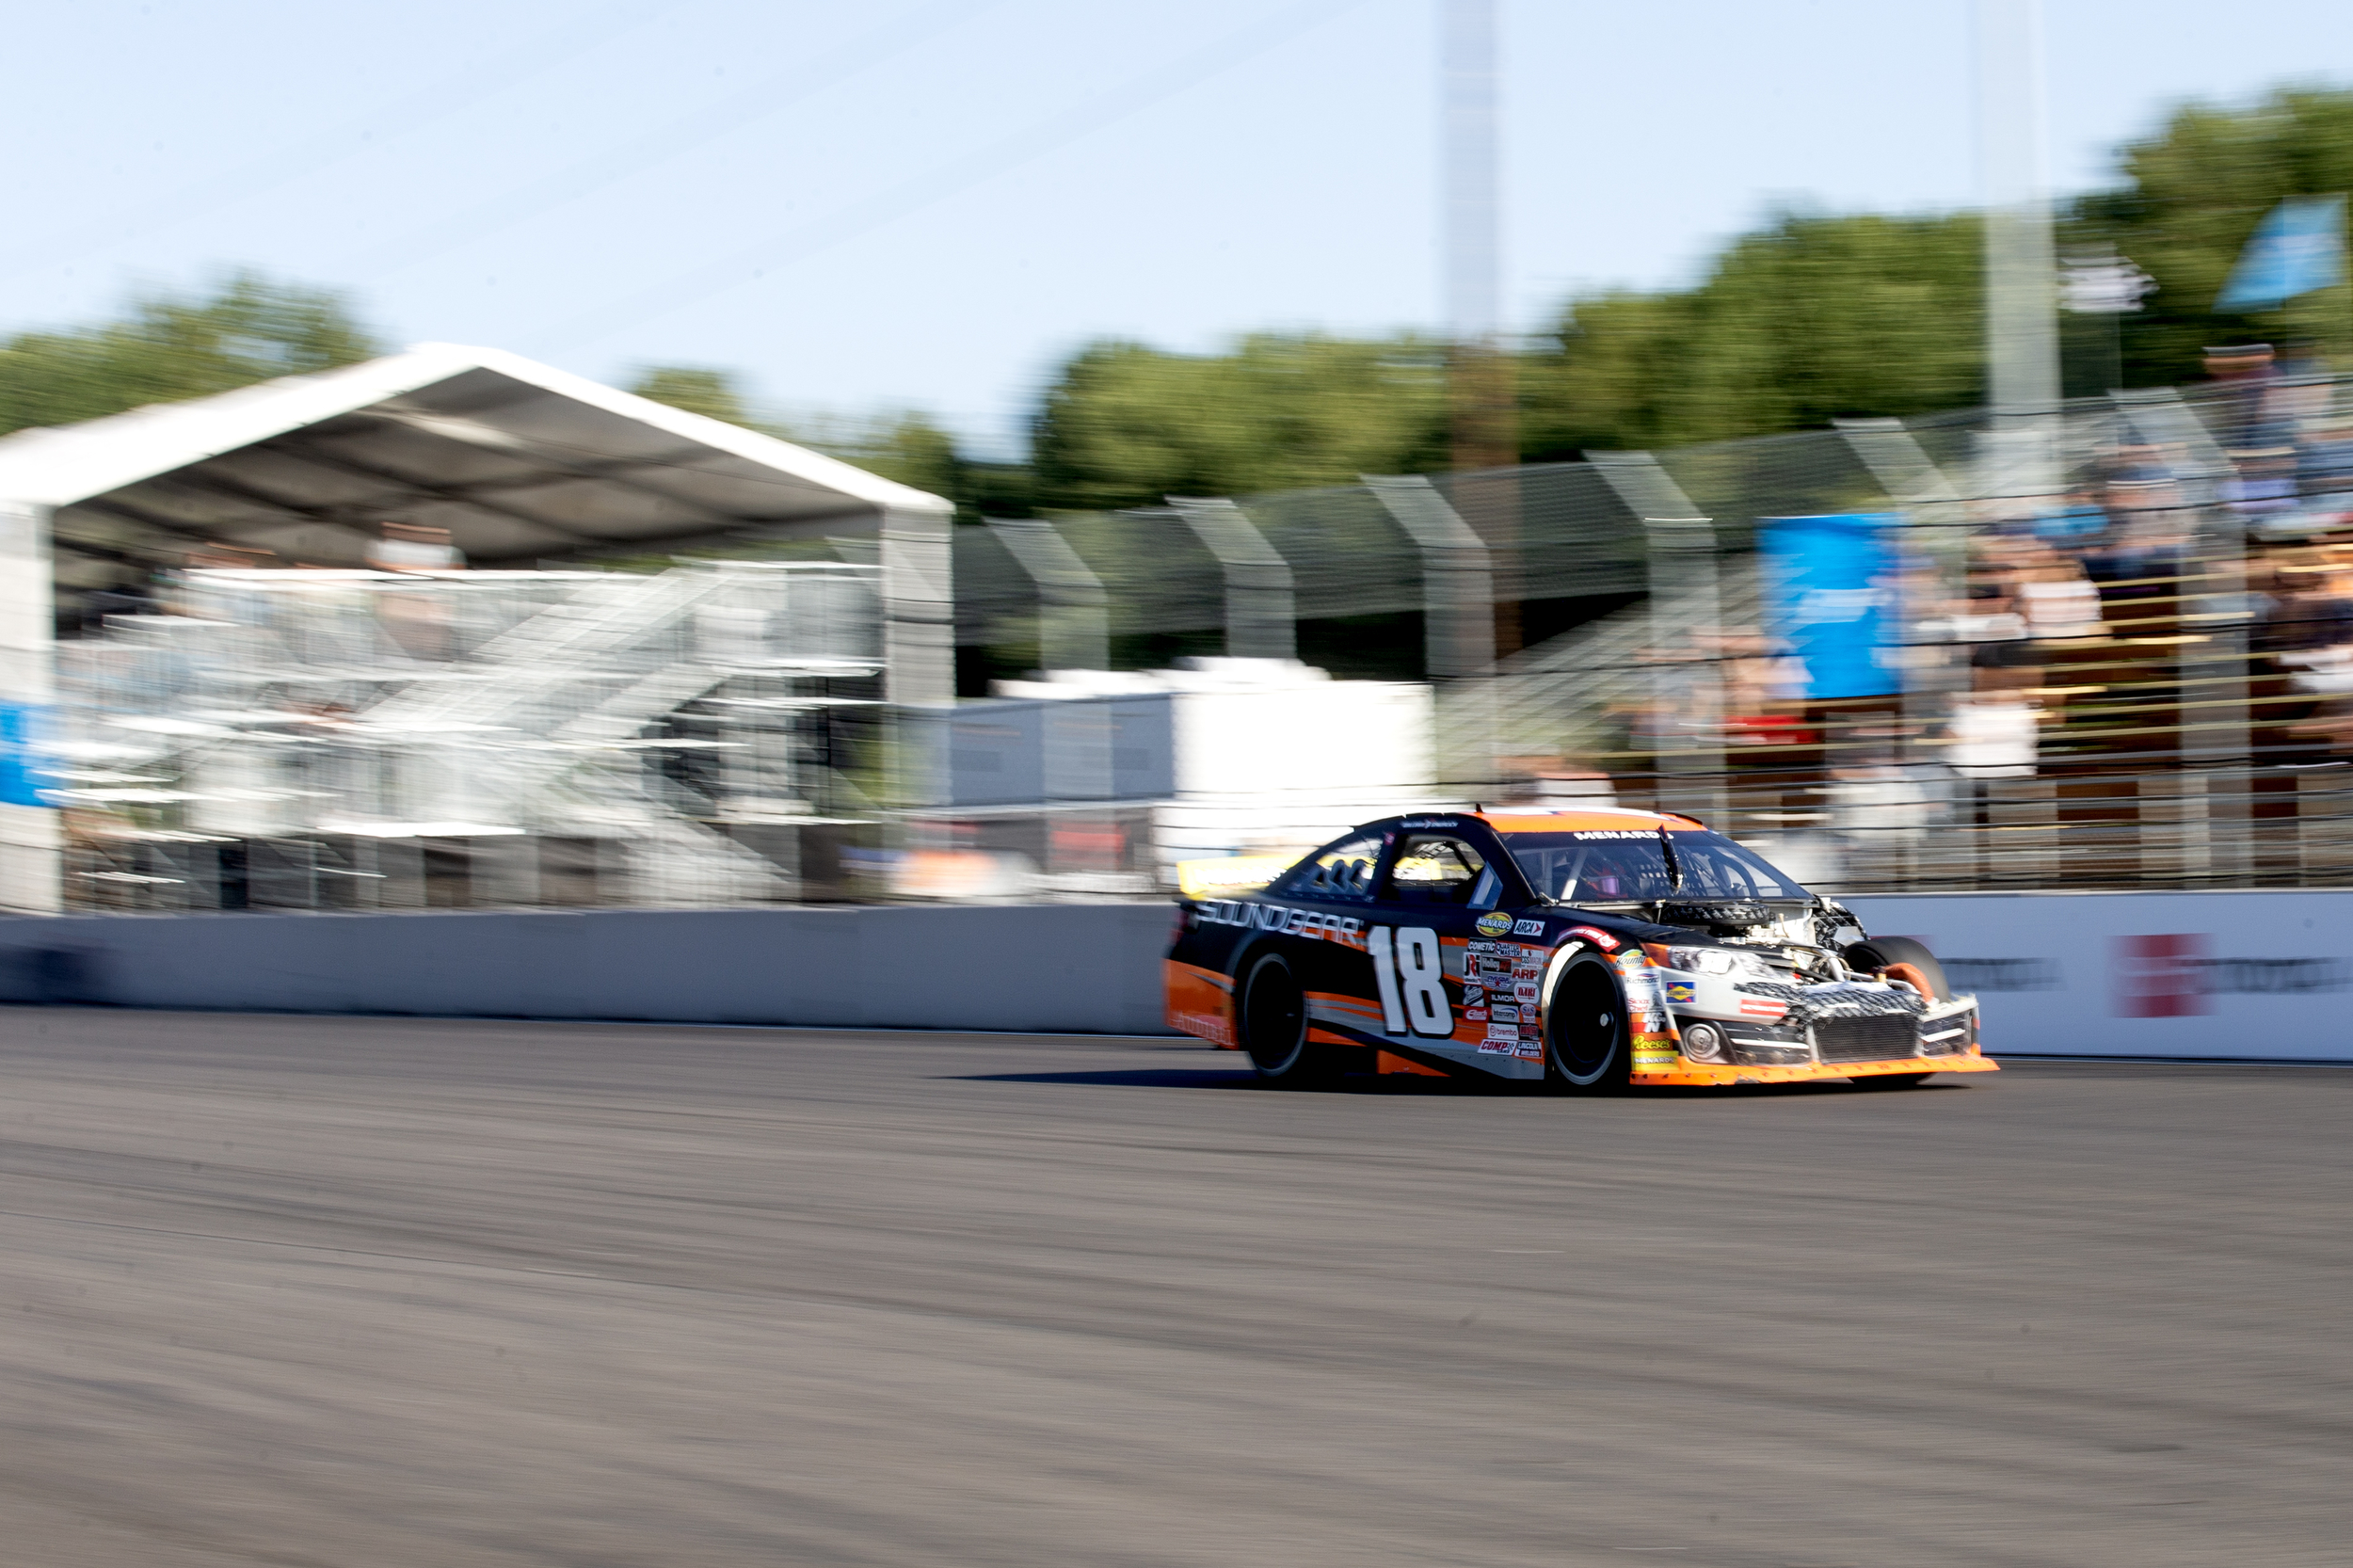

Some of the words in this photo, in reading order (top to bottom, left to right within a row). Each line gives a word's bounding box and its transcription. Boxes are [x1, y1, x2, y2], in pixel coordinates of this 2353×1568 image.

[1193, 899, 1360, 947] SOUNDGEAR
[1476, 917, 1513, 931] MENARDS
[1514, 921, 1535, 935] ARCA
[1468, 941, 1496, 952] COMETIC
[1482, 956, 1500, 971] Holley
[1615, 955, 1647, 968] Bounty
[1368, 925, 1454, 1035] 18
[1512, 968, 1539, 980] ARP
[1626, 975, 1659, 984] Richmond
[1491, 993, 1515, 1002] ILMOR
[1497, 1027, 1517, 1037] brembo
[1481, 1040, 1508, 1051] COMP
